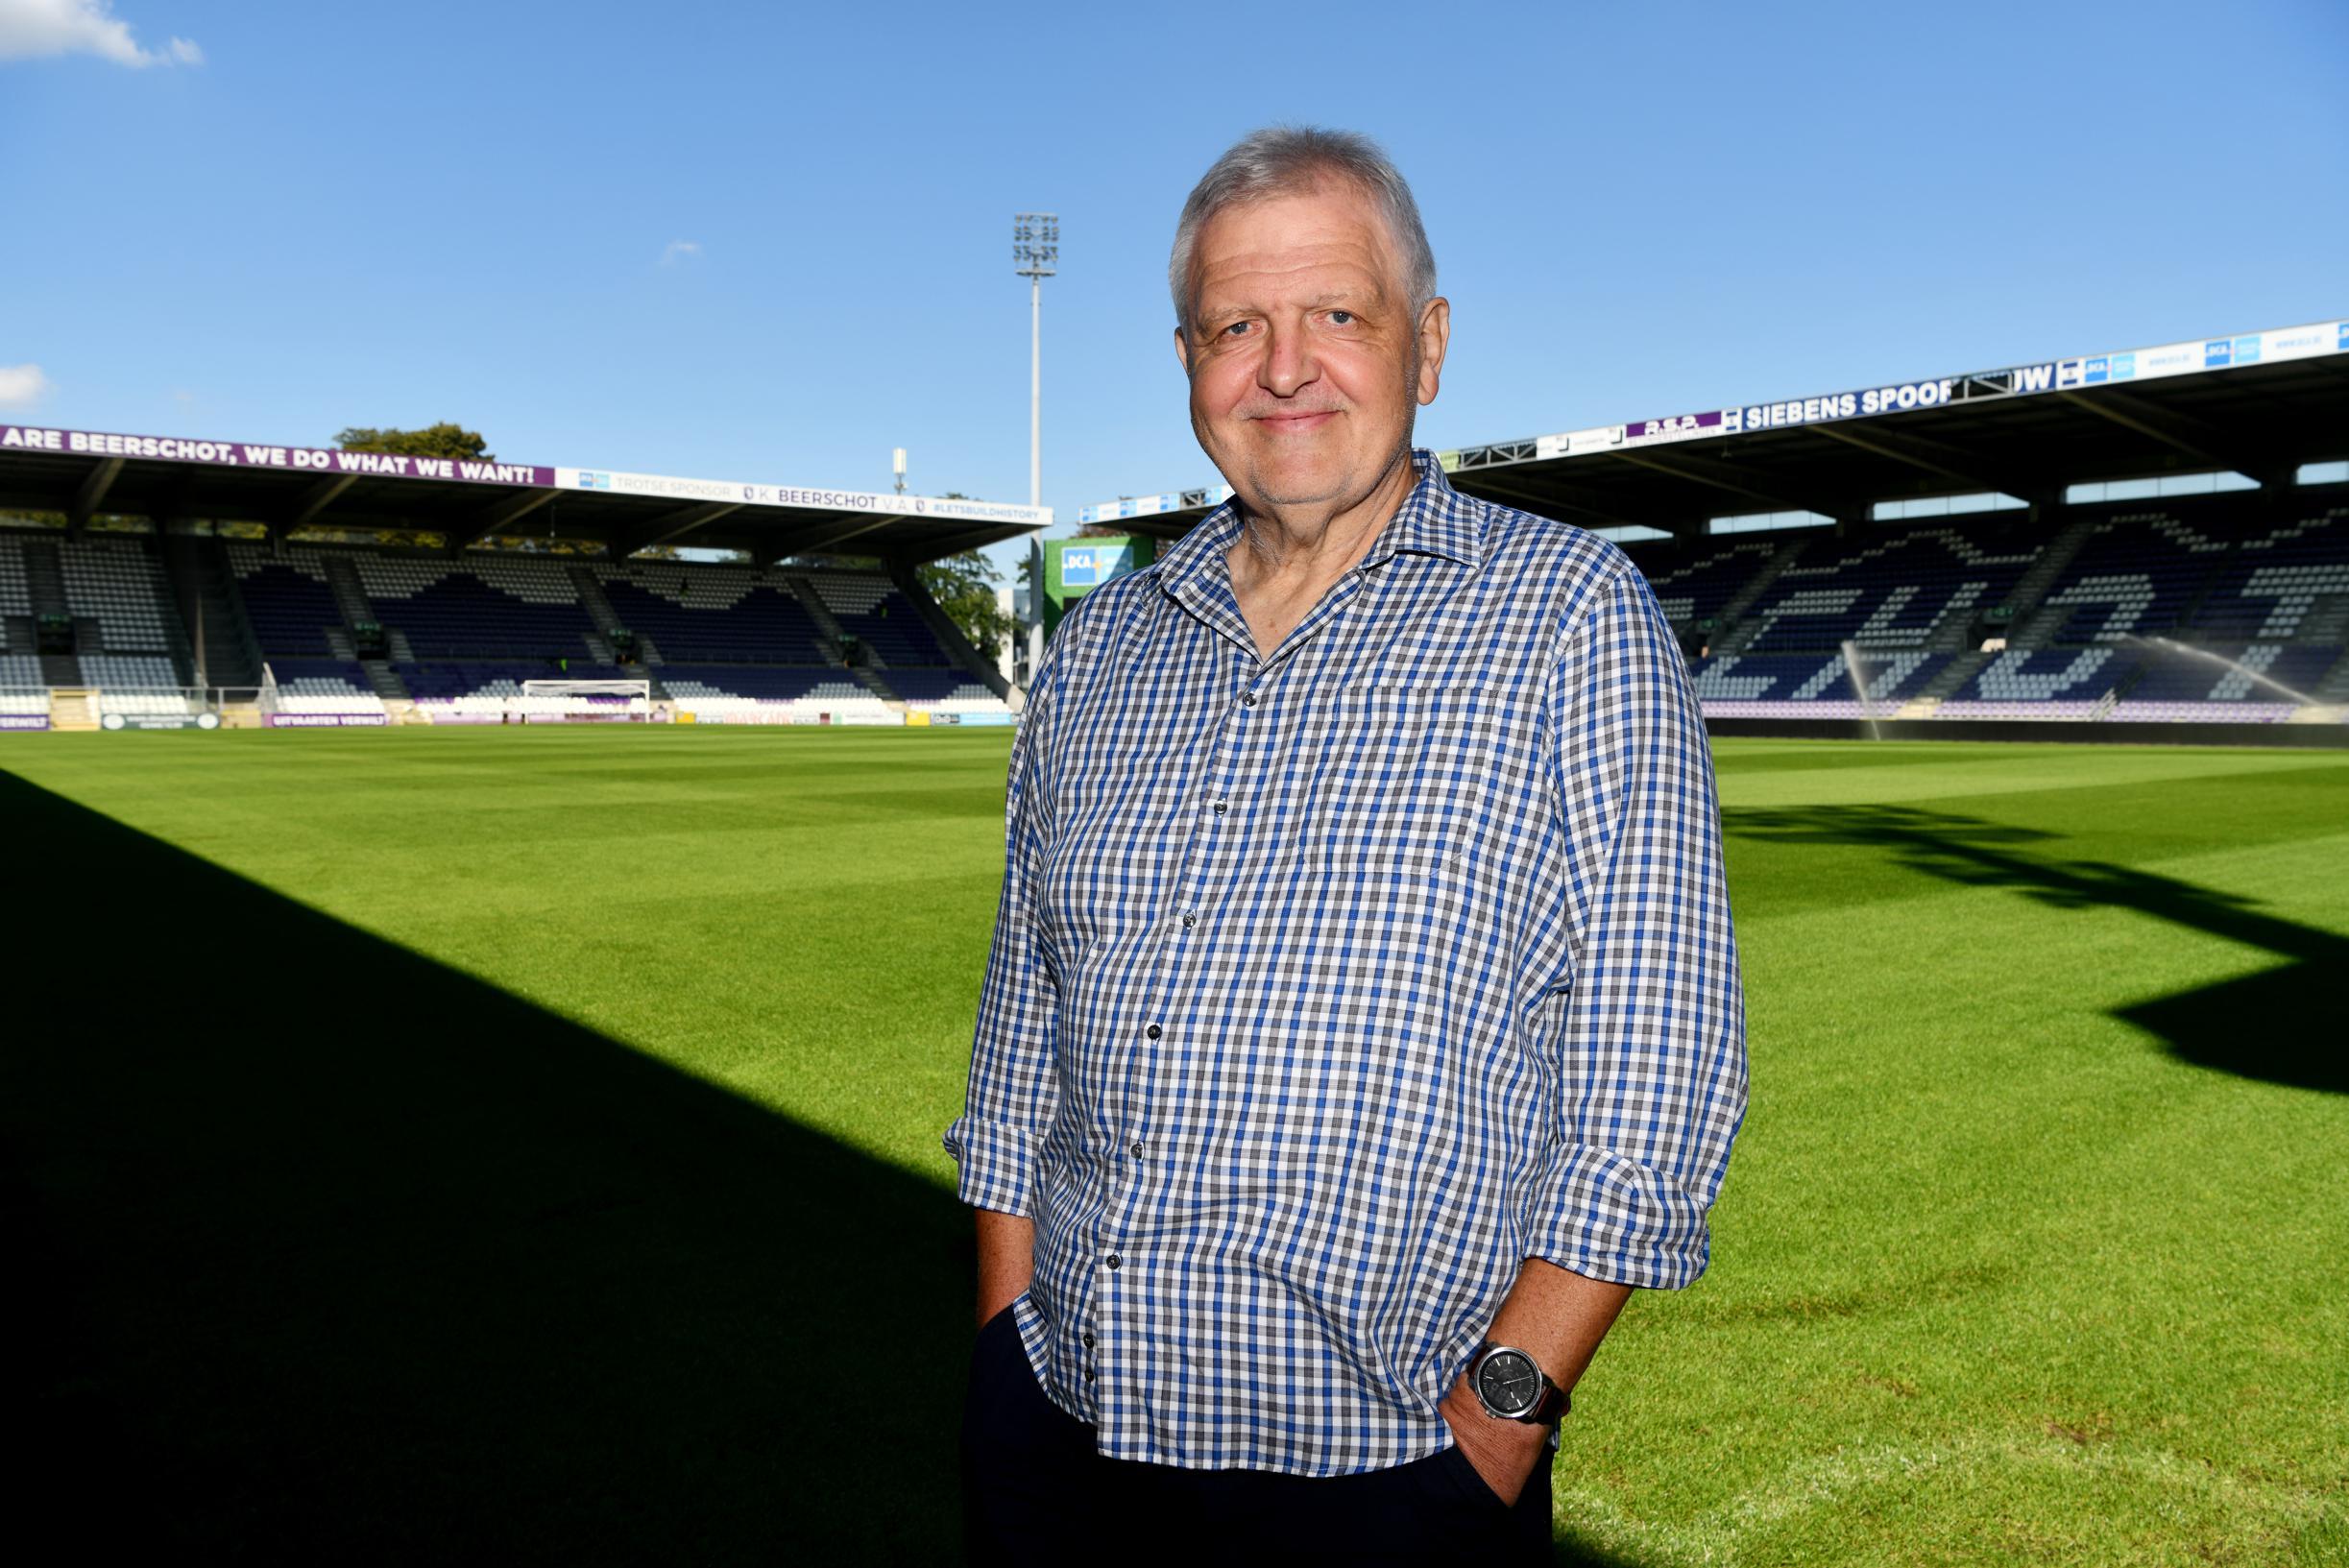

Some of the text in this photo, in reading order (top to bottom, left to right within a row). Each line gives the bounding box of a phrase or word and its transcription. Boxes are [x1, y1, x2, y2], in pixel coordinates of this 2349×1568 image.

[1746, 394, 1857, 429] SIEBENS
[2, 427, 534, 483] ARE BEERSCHOT, WE DO WHAT WE WANT!
[616, 476, 731, 496] TROTSE SPONSOR
[779, 489, 877, 509] BEERSCHOT
[933, 503, 1039, 519] #LETSBUILDHISTORY
